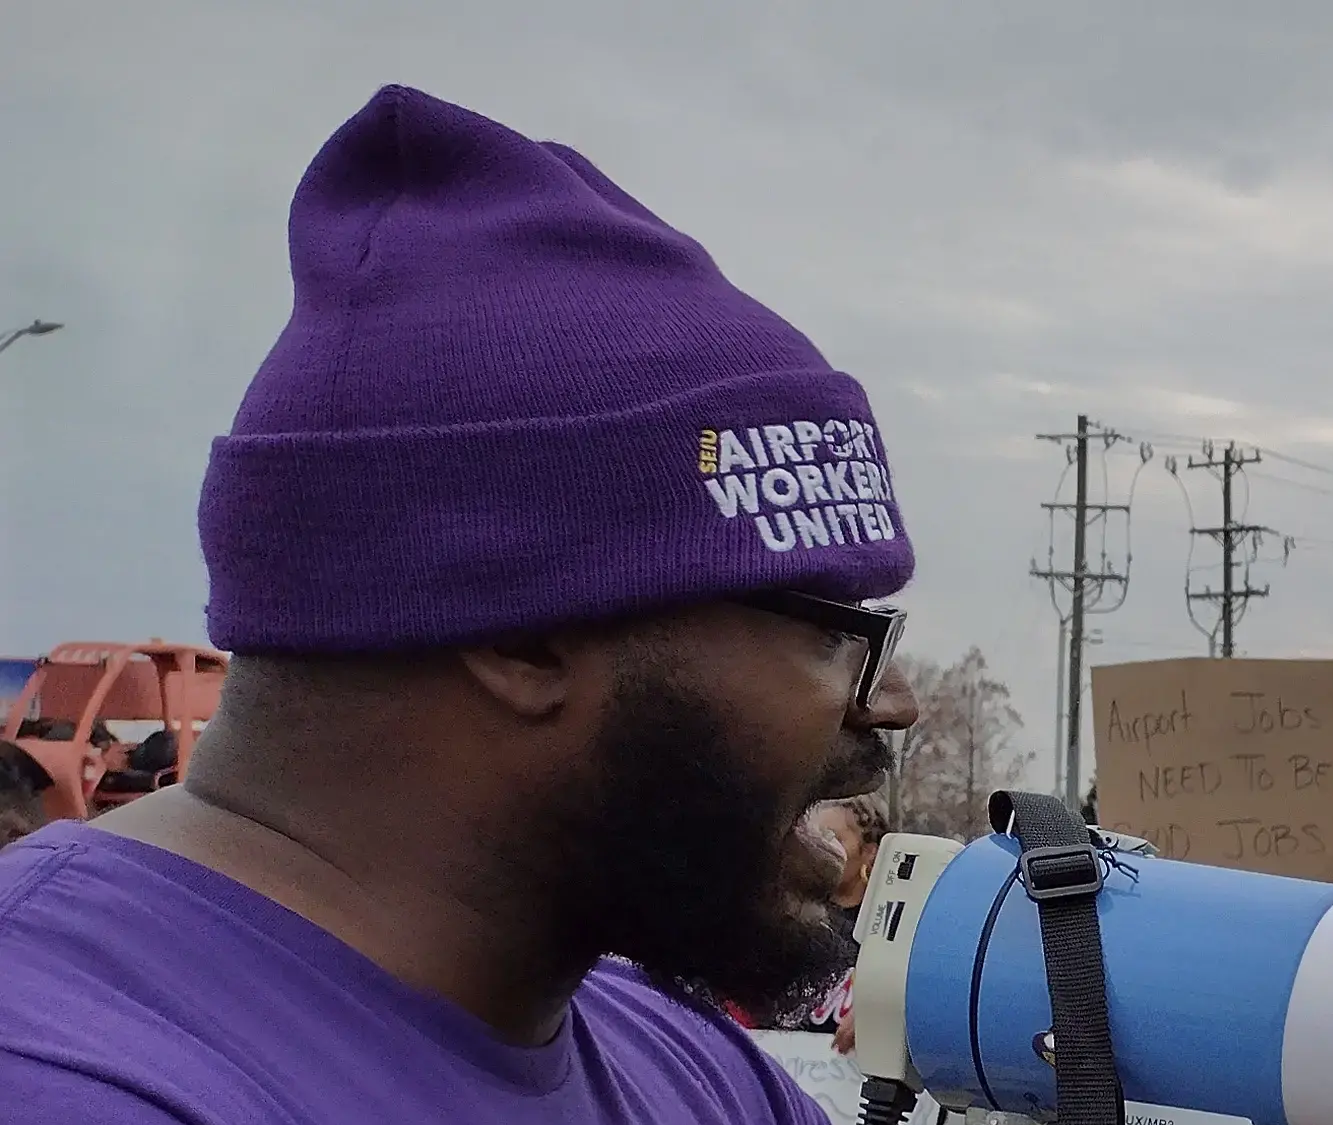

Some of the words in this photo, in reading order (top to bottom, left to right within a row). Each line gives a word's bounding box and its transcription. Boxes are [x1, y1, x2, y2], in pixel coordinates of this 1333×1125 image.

[698, 429, 718, 474] SEIU
[720, 418, 879, 473] AIRPORT
[754, 503, 896, 553] UNITED
[1108, 689, 1194, 756] Airport
[1230, 691, 1322, 735] Jobs
[1139, 763, 1222, 801] NEED
[1288, 754, 1333, 790] BE
[892, 850, 902, 863] ON
[1216, 818, 1326, 860] JOBS
[885, 869, 896, 885] OFF
[870, 904, 887, 935] VOLUME
